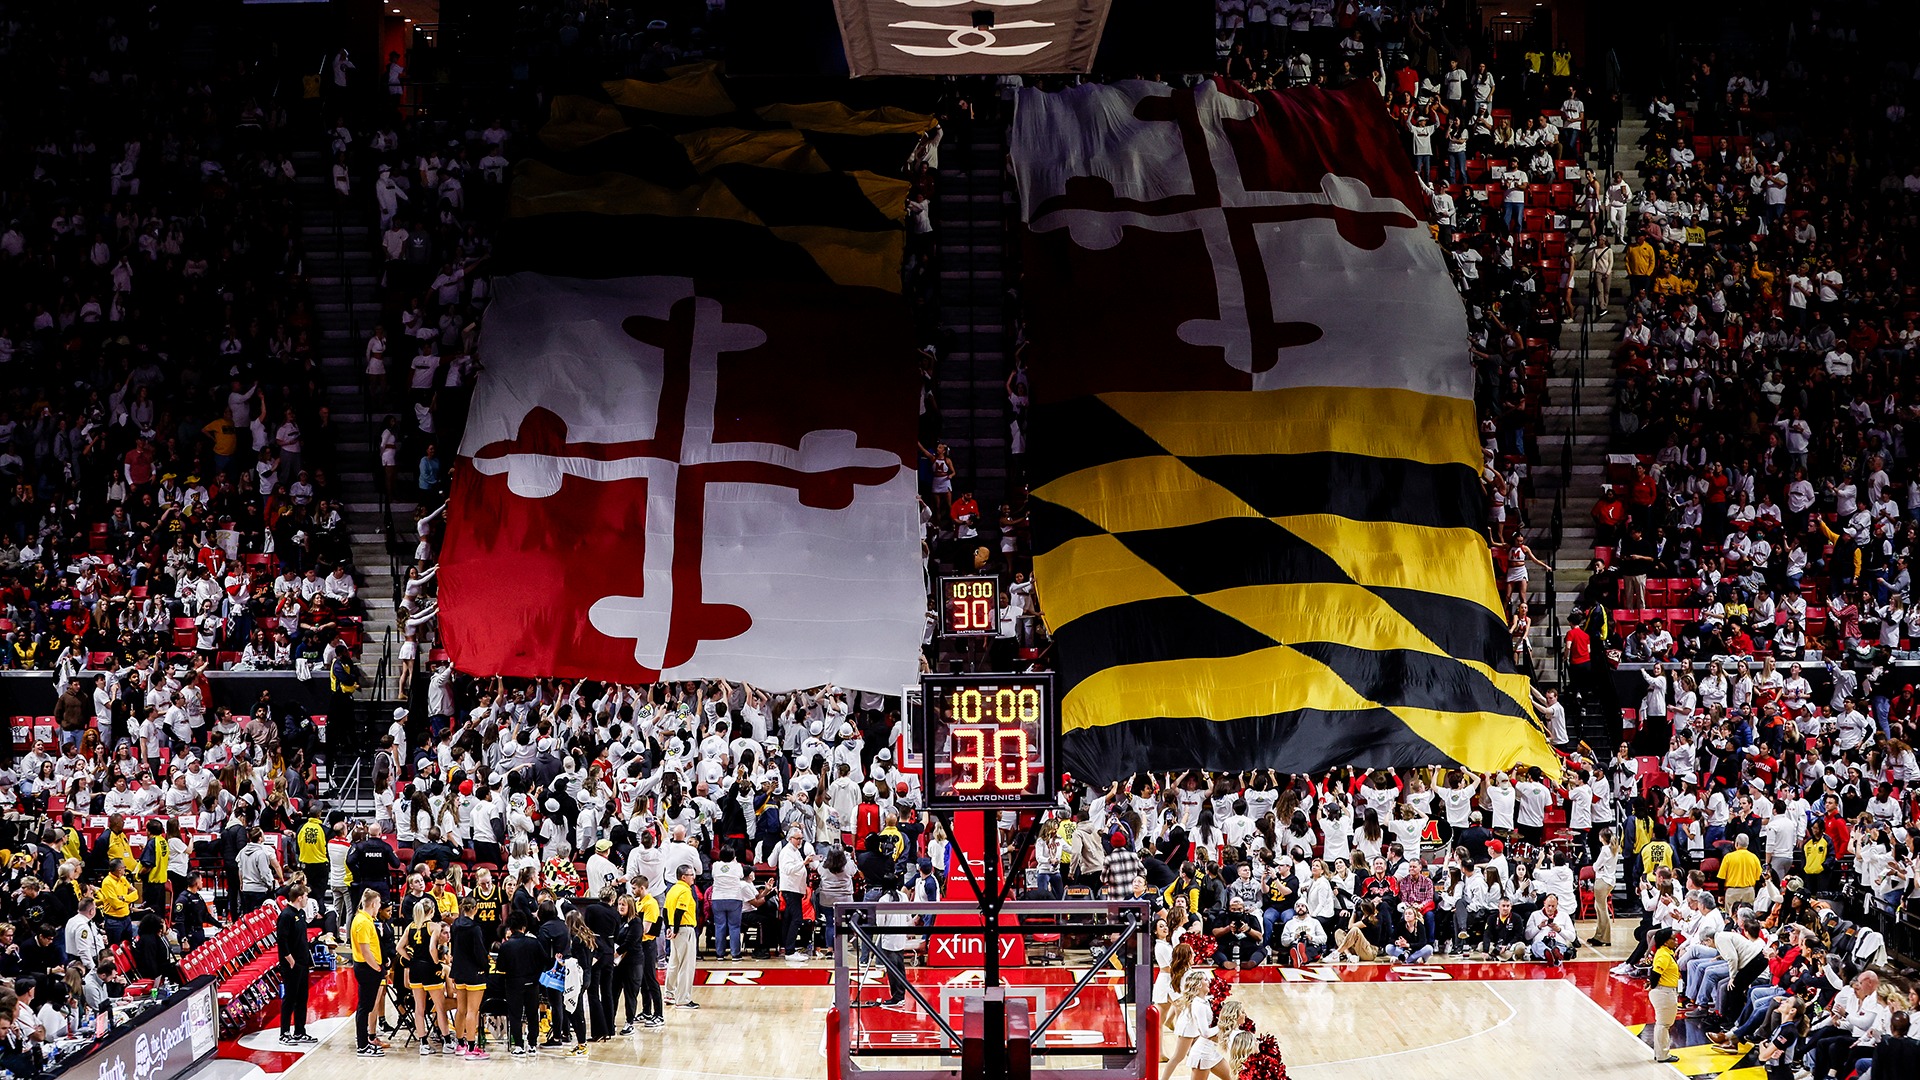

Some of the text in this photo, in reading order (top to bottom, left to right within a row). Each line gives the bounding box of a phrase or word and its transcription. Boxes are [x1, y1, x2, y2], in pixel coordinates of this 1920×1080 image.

[953, 582, 992, 598] 10:00
[953, 600, 988, 628] 30
[952, 688, 1039, 723] 10:00
[952, 729, 1028, 790] 30
[959, 794, 1021, 802] DAKTRONICS
[867, 812, 871, 826] 1
[479, 910, 495, 921] 44
[413, 930, 422, 944] 4
[936, 934, 1016, 960] xfiny
